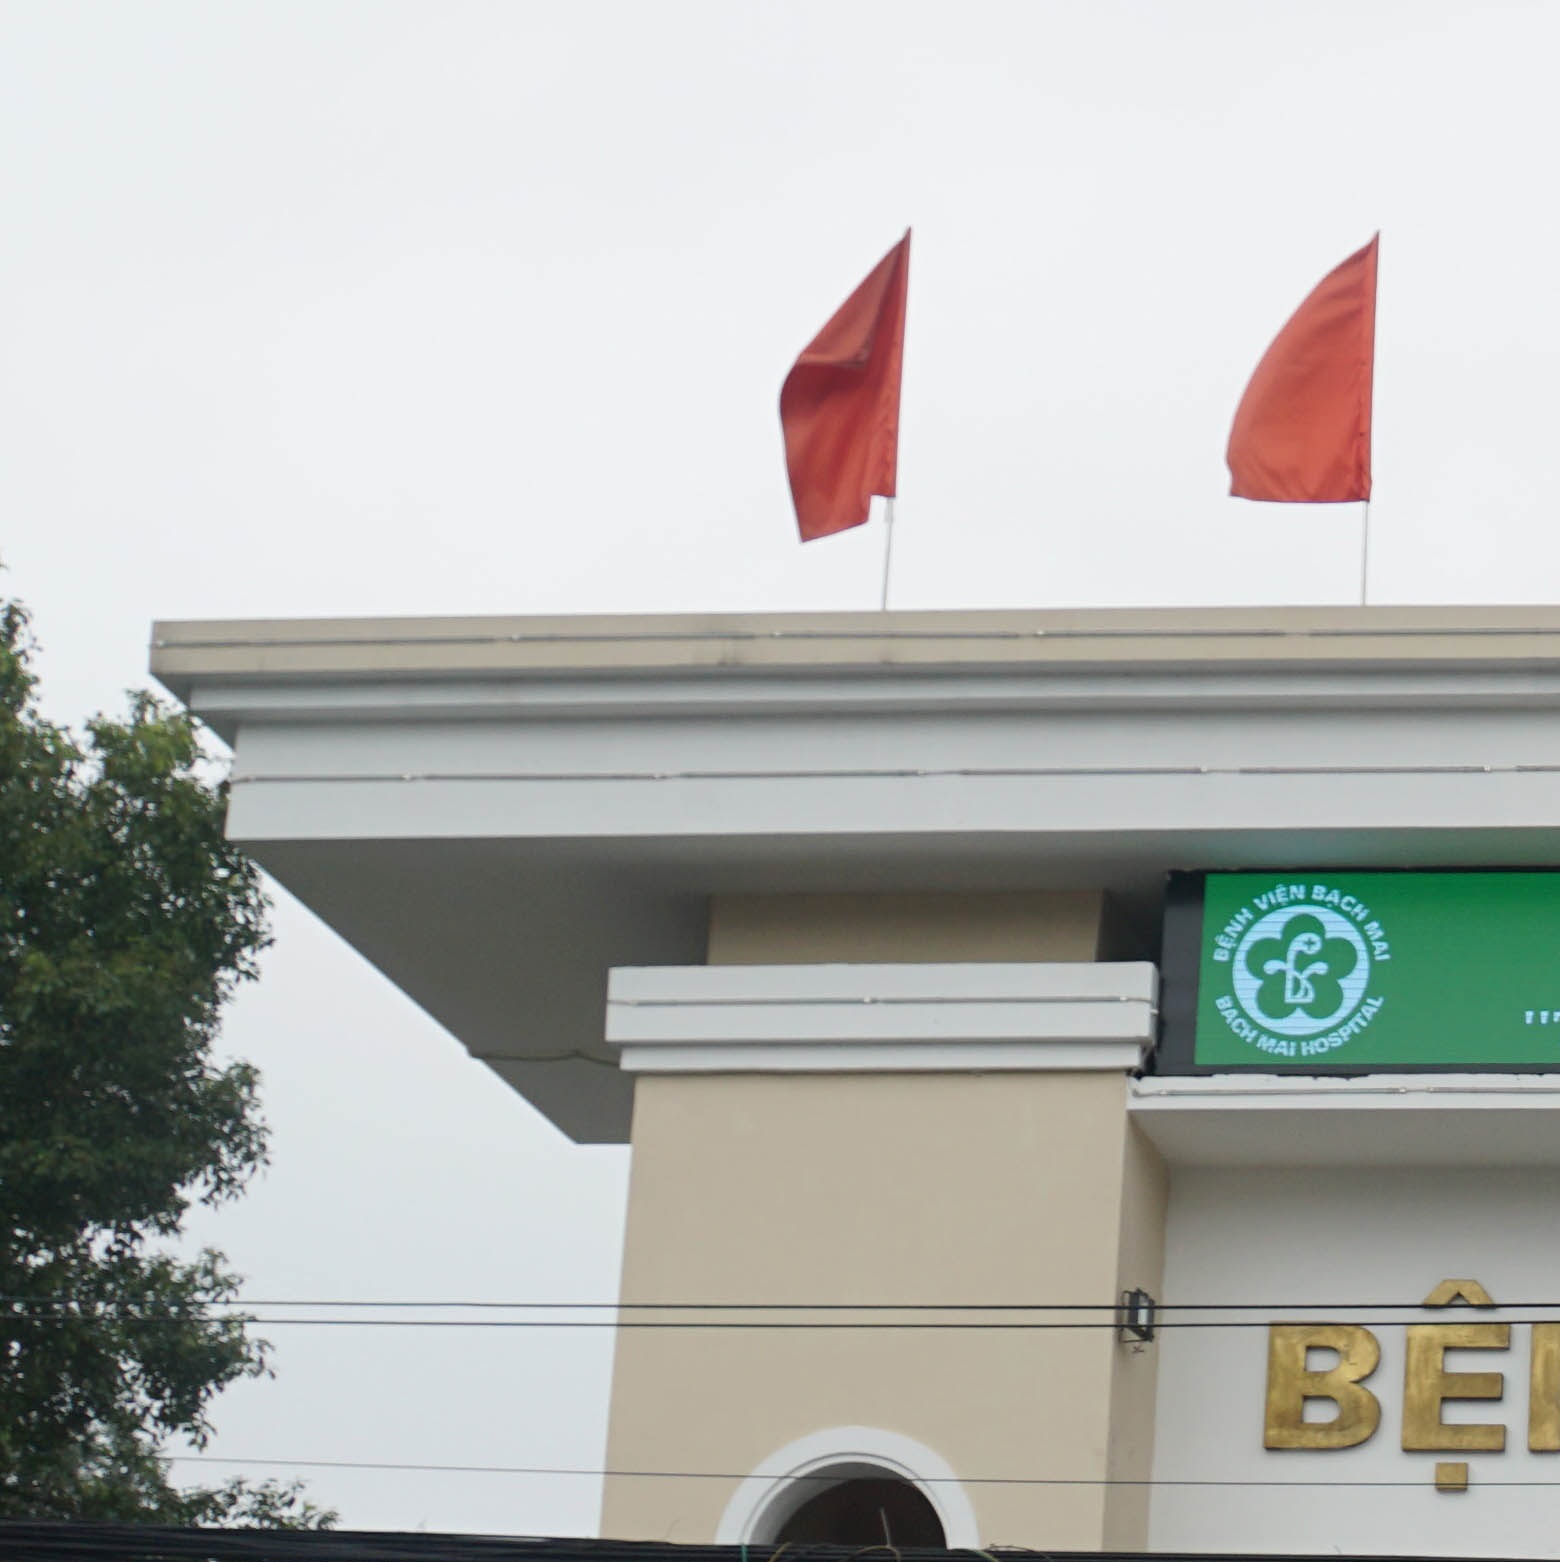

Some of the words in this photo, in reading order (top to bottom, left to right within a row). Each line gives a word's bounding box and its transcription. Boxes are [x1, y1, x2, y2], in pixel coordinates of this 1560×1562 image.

[1253, 884, 1306, 910] VIỆN
[1364, 921, 1391, 961] MAI
[1256, 1034, 1296, 1056] MAI
[1301, 997, 1385, 1056] HOSPITAL
